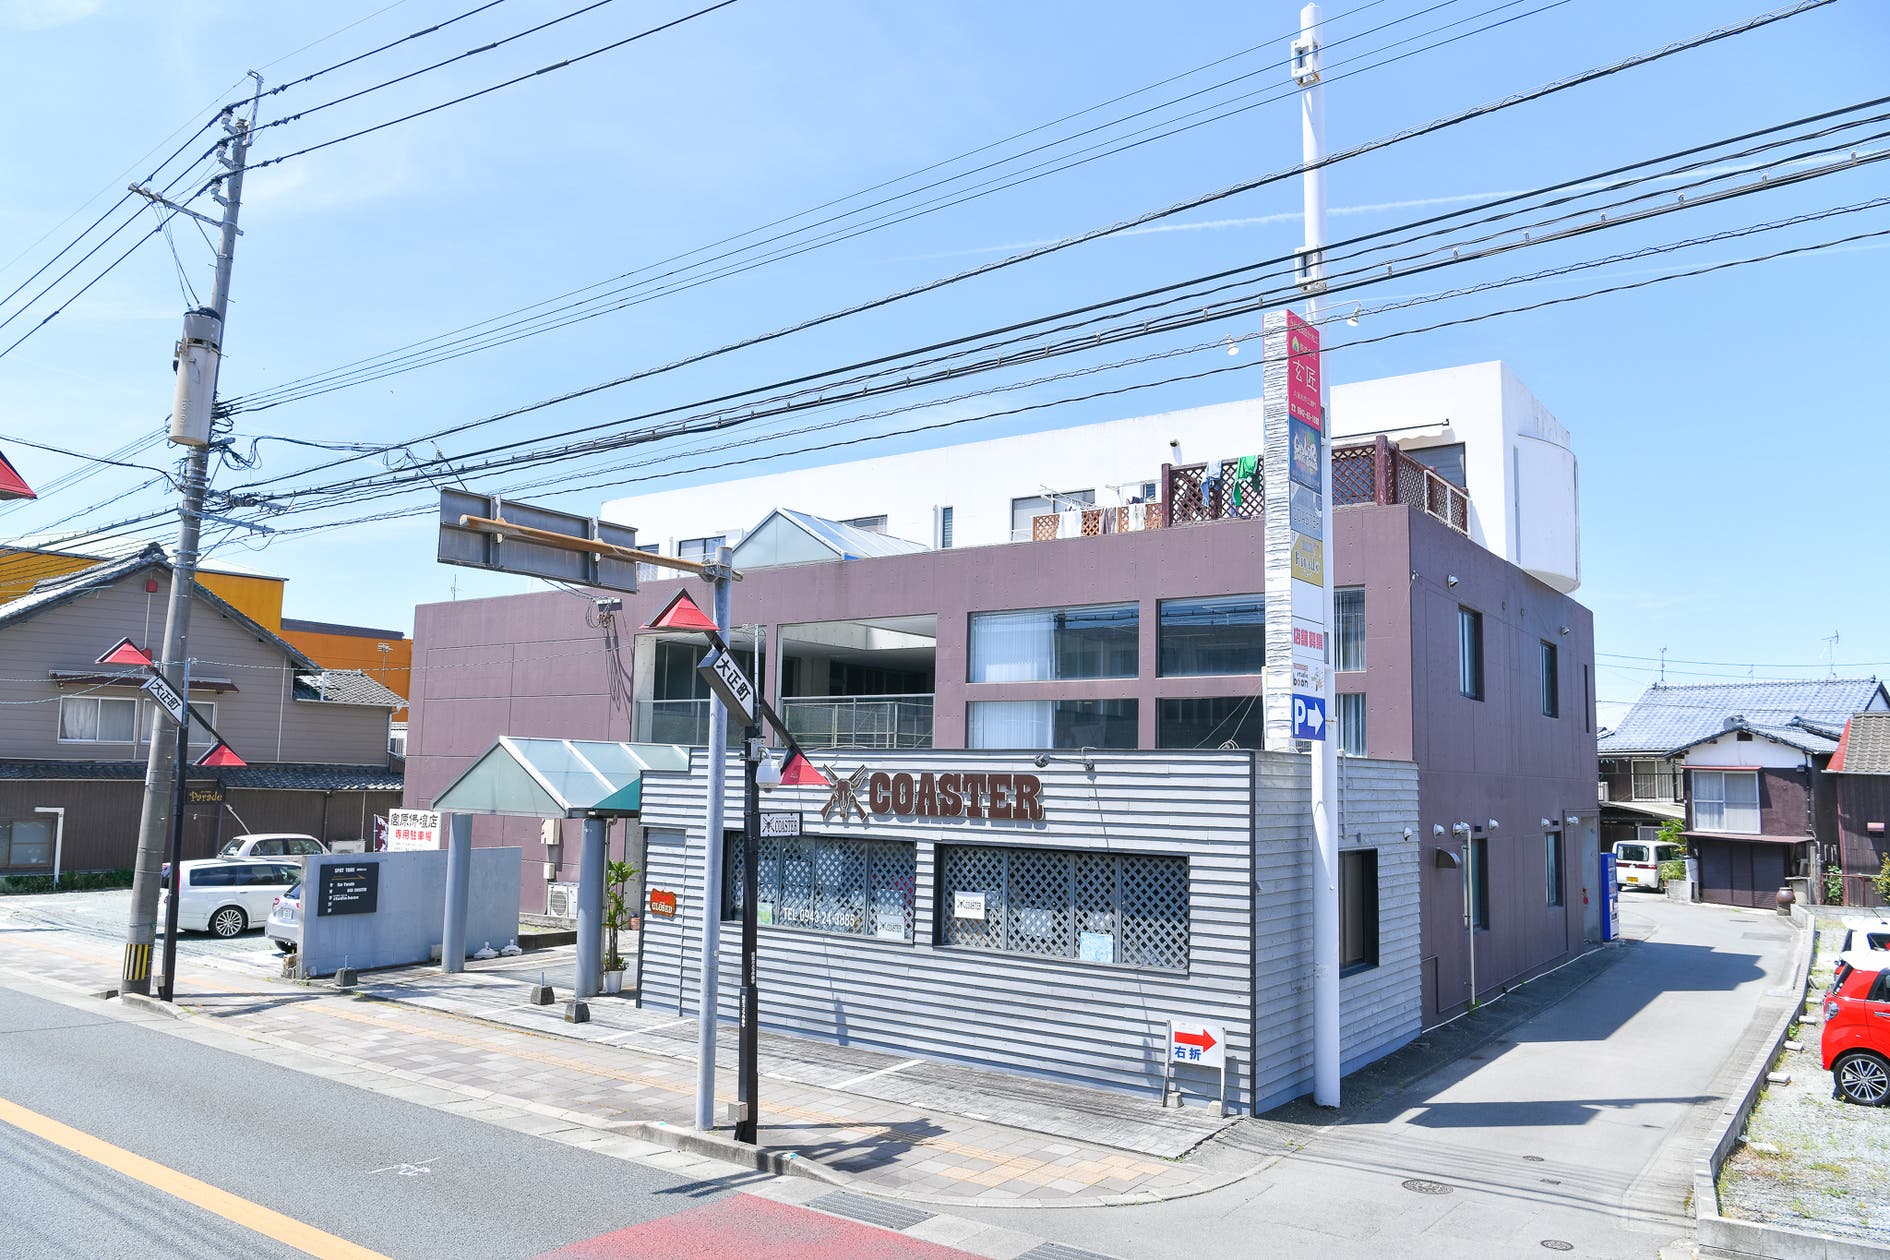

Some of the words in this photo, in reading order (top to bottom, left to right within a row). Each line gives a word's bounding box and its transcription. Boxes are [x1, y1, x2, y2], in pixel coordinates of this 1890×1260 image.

[1293, 360, 1318, 393] 玄匠
[716, 658, 751, 701] 大正町
[151, 682, 181, 711] 大正町
[1294, 698, 1306, 735] P
[191, 791, 222, 801] Parade
[869, 772, 1044, 821] COASTER
[395, 829, 432, 841] 専用駐車場
[775, 820, 798, 833] COASTER
[783, 907, 797, 921] TEL
[1174, 1045, 1202, 1062] 右折
